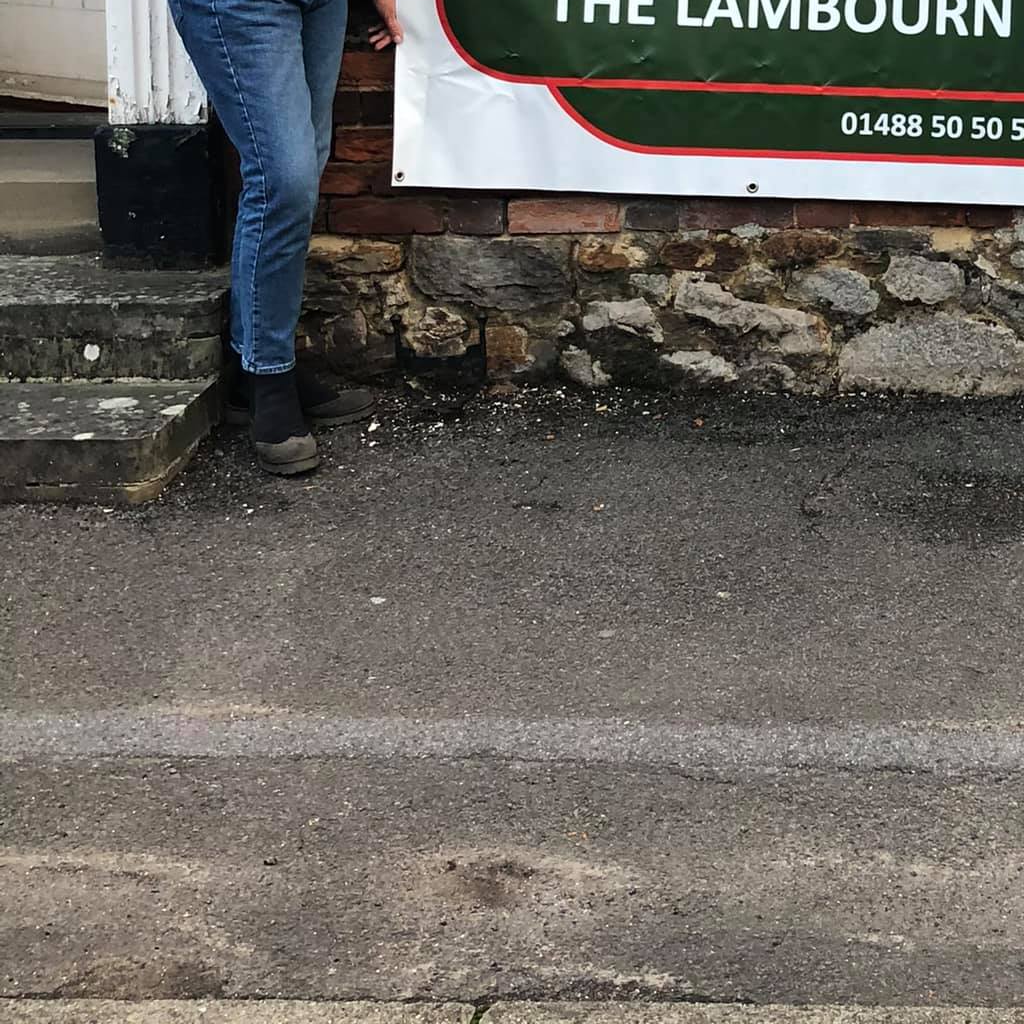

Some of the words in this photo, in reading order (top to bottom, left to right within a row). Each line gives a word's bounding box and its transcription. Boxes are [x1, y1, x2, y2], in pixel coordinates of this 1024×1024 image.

[841, 111, 923, 138] 01488
[930, 115, 963, 139] 50
[970, 116, 1003, 140] 50
